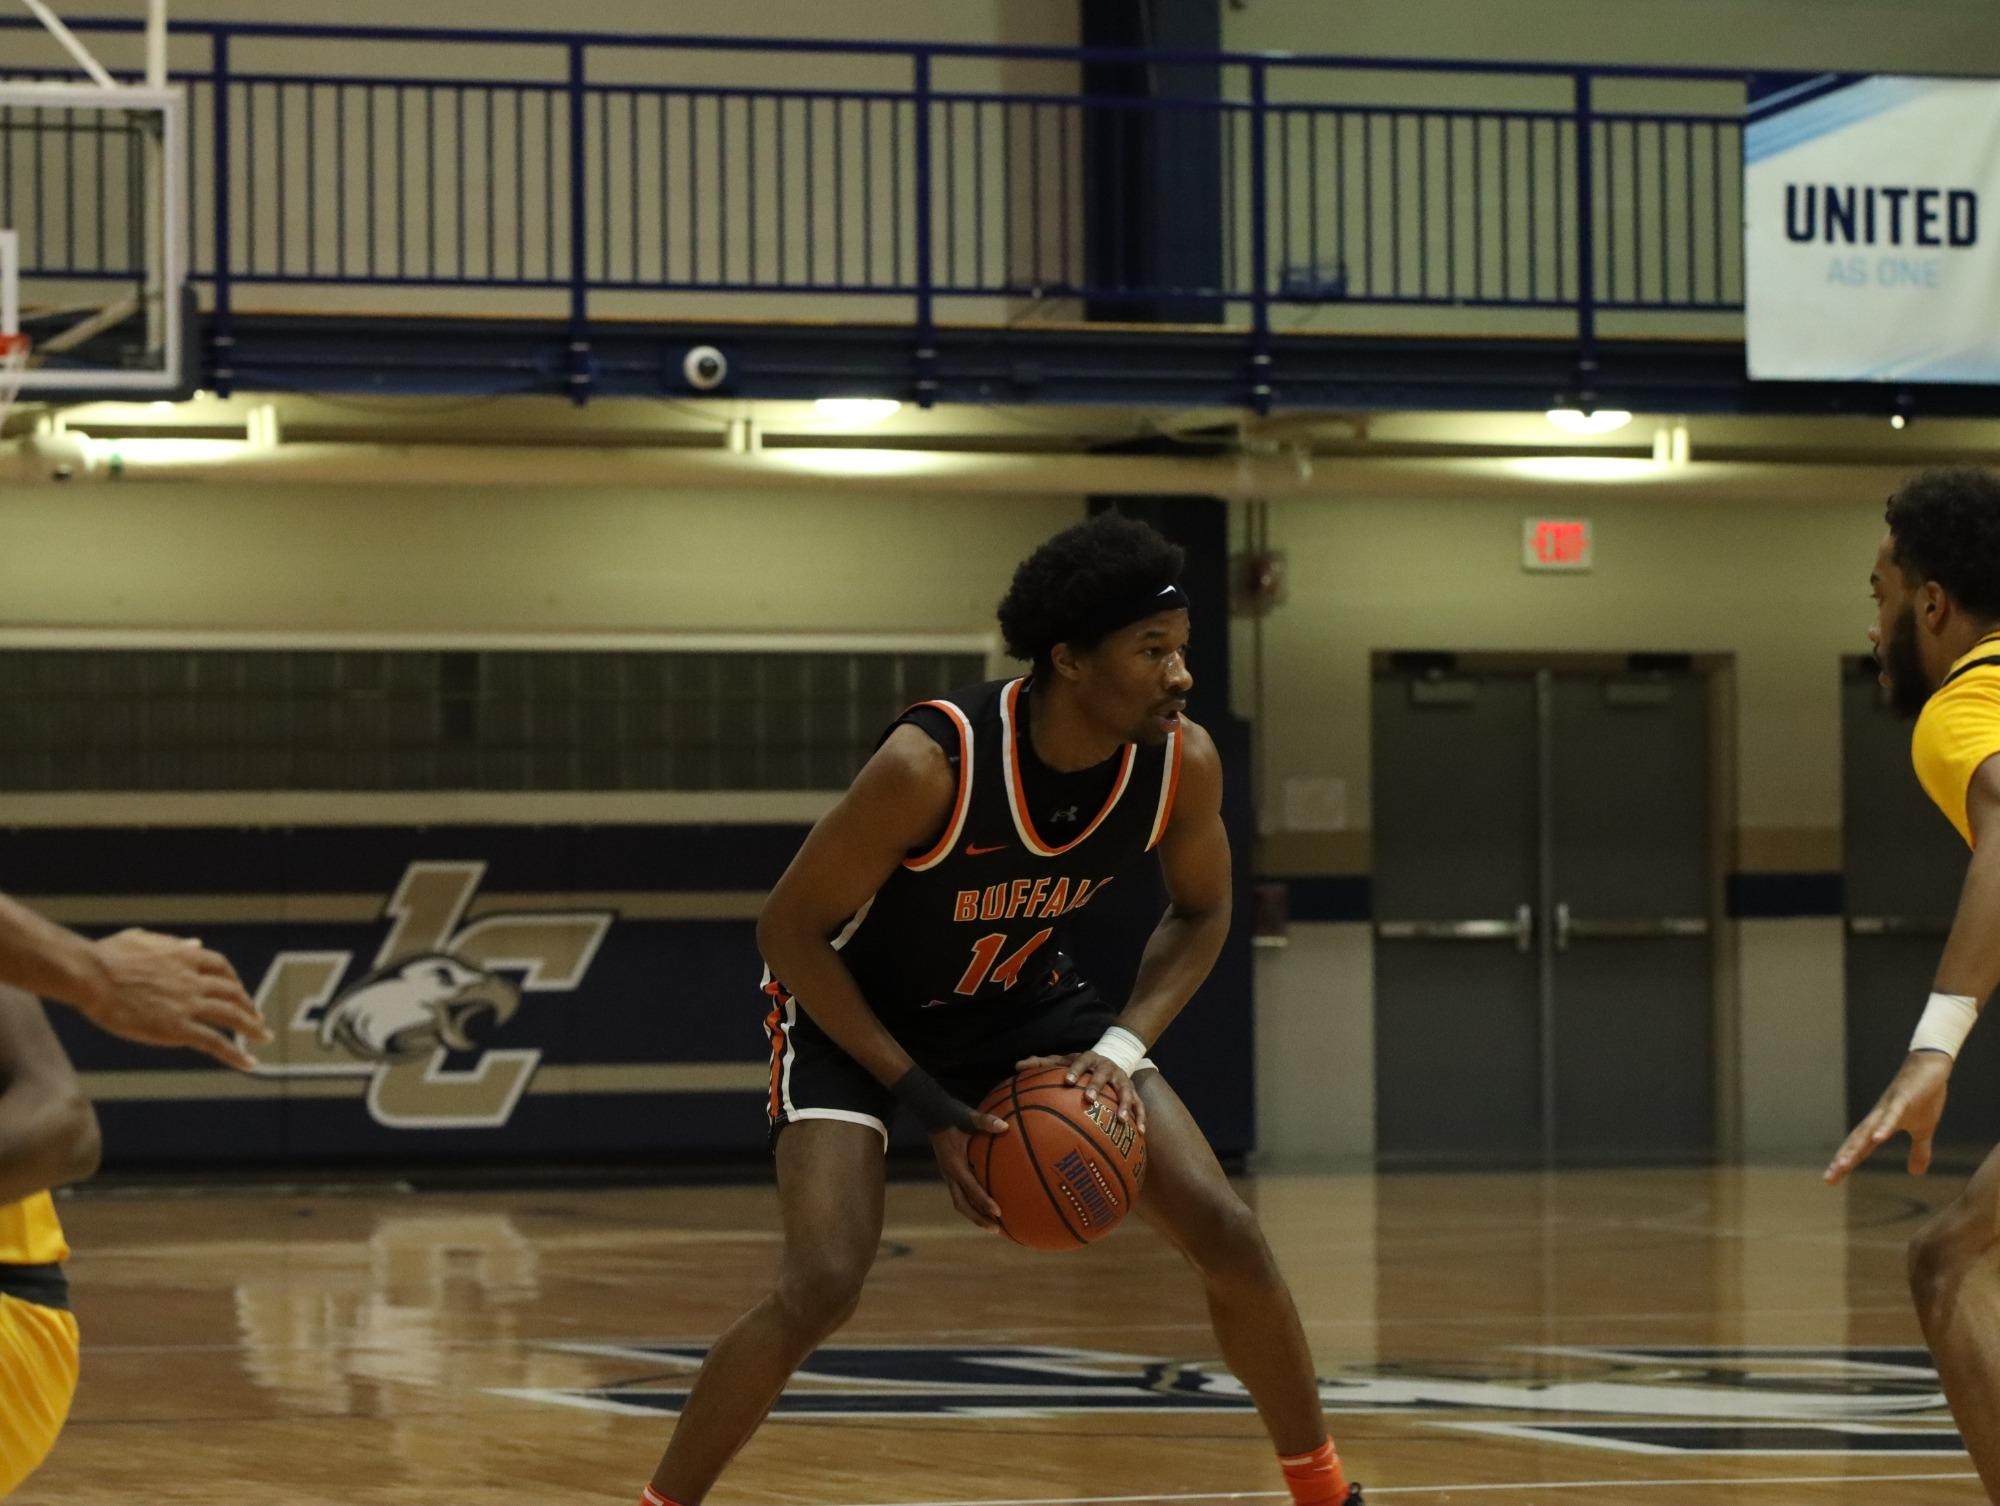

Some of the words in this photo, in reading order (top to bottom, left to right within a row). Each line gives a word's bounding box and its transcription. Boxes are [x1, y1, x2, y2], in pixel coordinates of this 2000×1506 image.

[1786, 183, 1977, 248] UNITED
[1827, 256, 1866, 287] AS
[1877, 258, 1940, 289] ONE
[953, 876, 1114, 922] BUFFAL
[953, 926, 1054, 996] 14
[1084, 1103, 1136, 1161] ROCK
